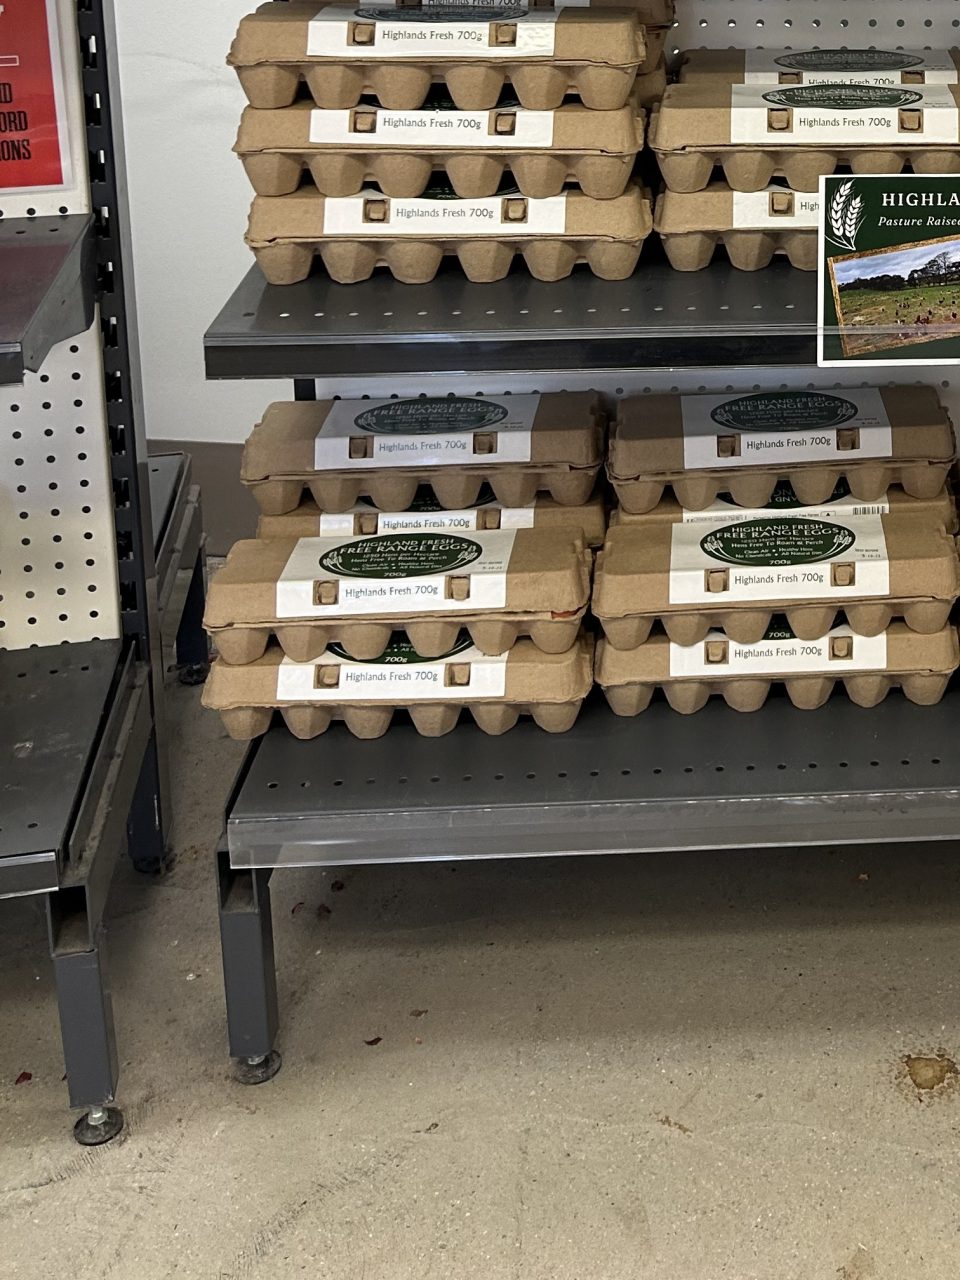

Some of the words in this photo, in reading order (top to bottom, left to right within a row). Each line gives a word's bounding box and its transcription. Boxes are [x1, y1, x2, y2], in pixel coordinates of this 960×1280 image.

[382, 30, 426, 40] Highlands
[430, 31, 453, 40] Fresh
[458, 31, 482, 41] 700g
[384, 118, 426, 128] Highlands
[430, 118, 453, 127] Fresh
[457, 119, 481, 130] 700g
[800, 118, 840, 128] Highlands
[843, 118, 864, 126] Fresh
[868, 118, 891, 128] 700g
[878, 217, 923, 227] Pasture
[747, 439, 784, 450] Highlands
[787, 438, 806, 446] Fresh
[810, 437, 831, 446] 700g
[735, 575, 774, 586] Highlands
[777, 574, 798, 582] Fresh
[802, 573, 823, 583] 700g
[346, 588, 386, 598] Highlands
[390, 587, 411, 595] Fresh
[415, 585, 438, 595] 700g
[735, 648, 773, 658] Highlands
[776, 648, 796, 656] Fresh
[800, 646, 822, 656] 700g
[346, 672, 386, 682] Highlands
[390, 672, 411, 680] Fresh
[415, 671, 438, 682] 700g
